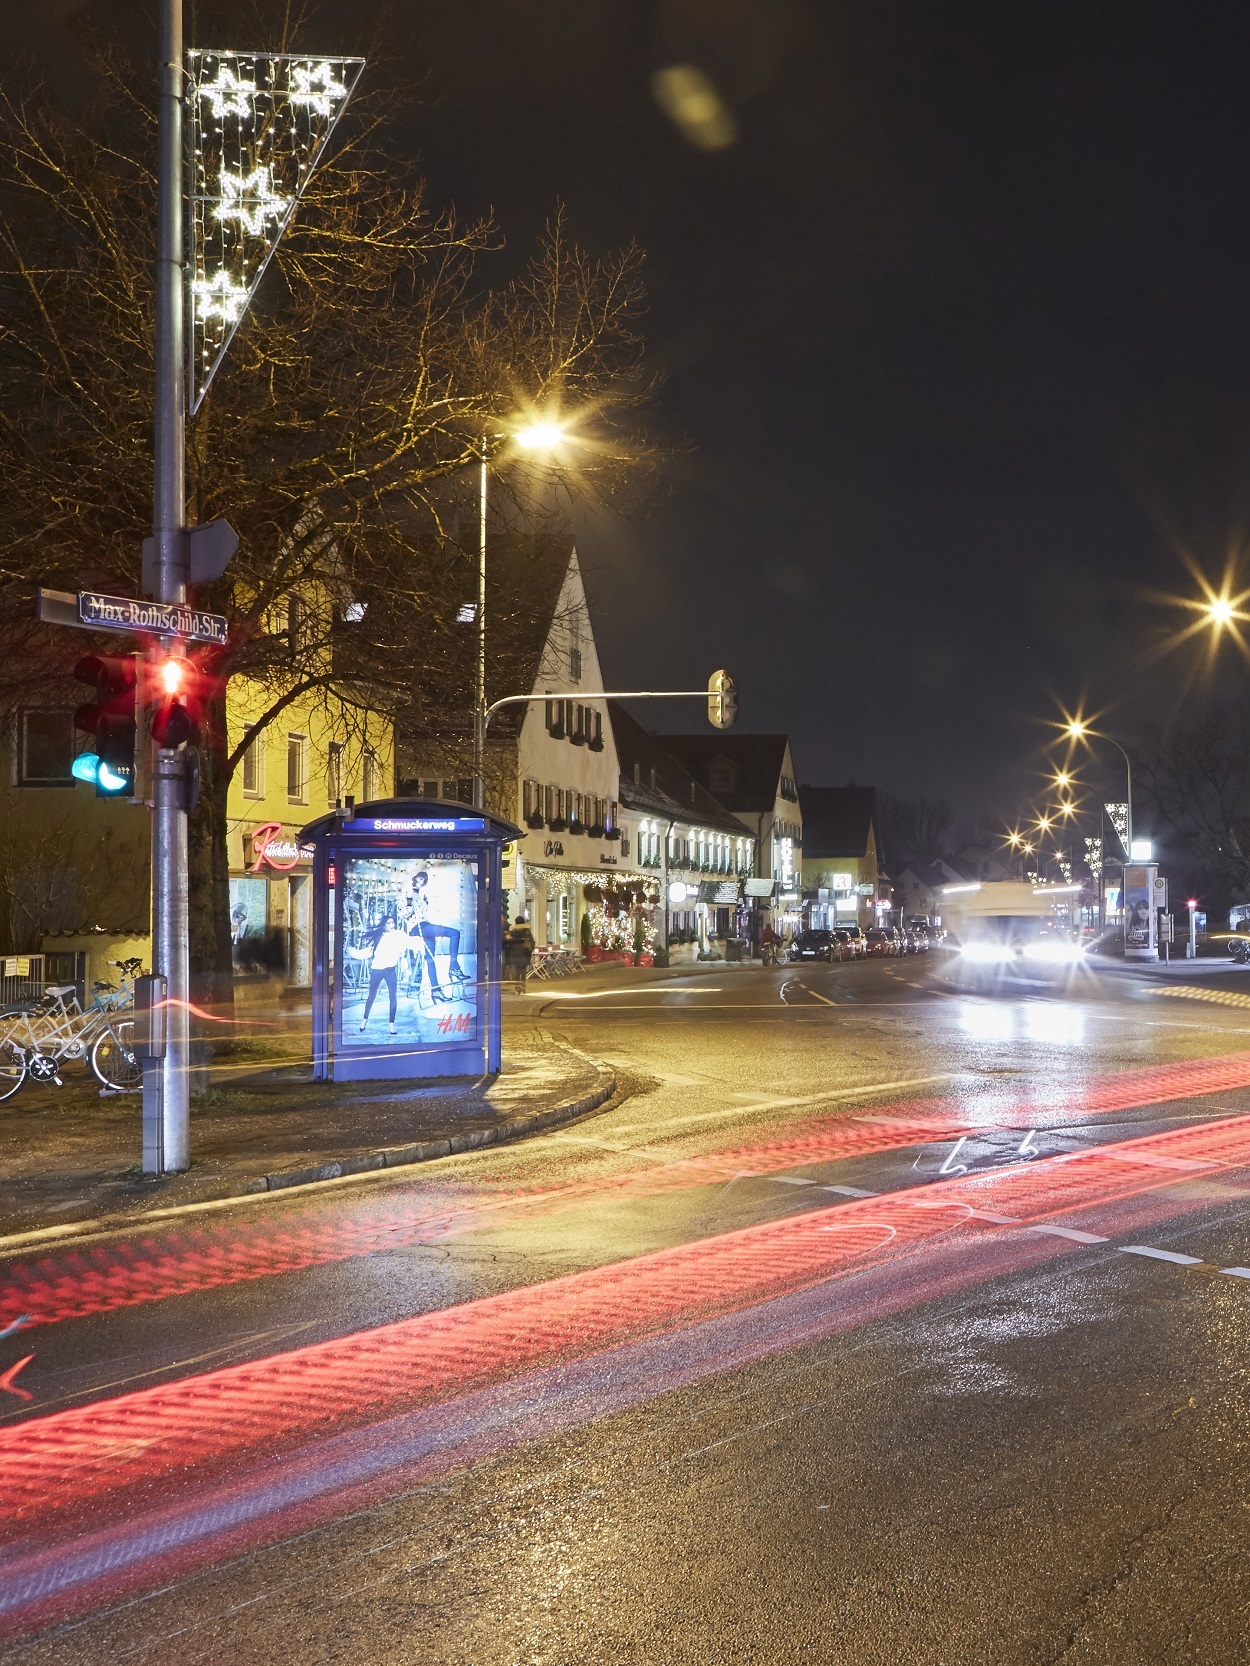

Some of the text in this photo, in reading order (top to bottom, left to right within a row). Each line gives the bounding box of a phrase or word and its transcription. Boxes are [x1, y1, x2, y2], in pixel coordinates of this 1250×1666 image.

[90, 596, 222, 637] Max-Rothschild-Str.
[374, 820, 455, 831] Schmuckerweg
[781, 837, 793, 883] HOTEL
[437, 1012, 471, 1034] H&M
